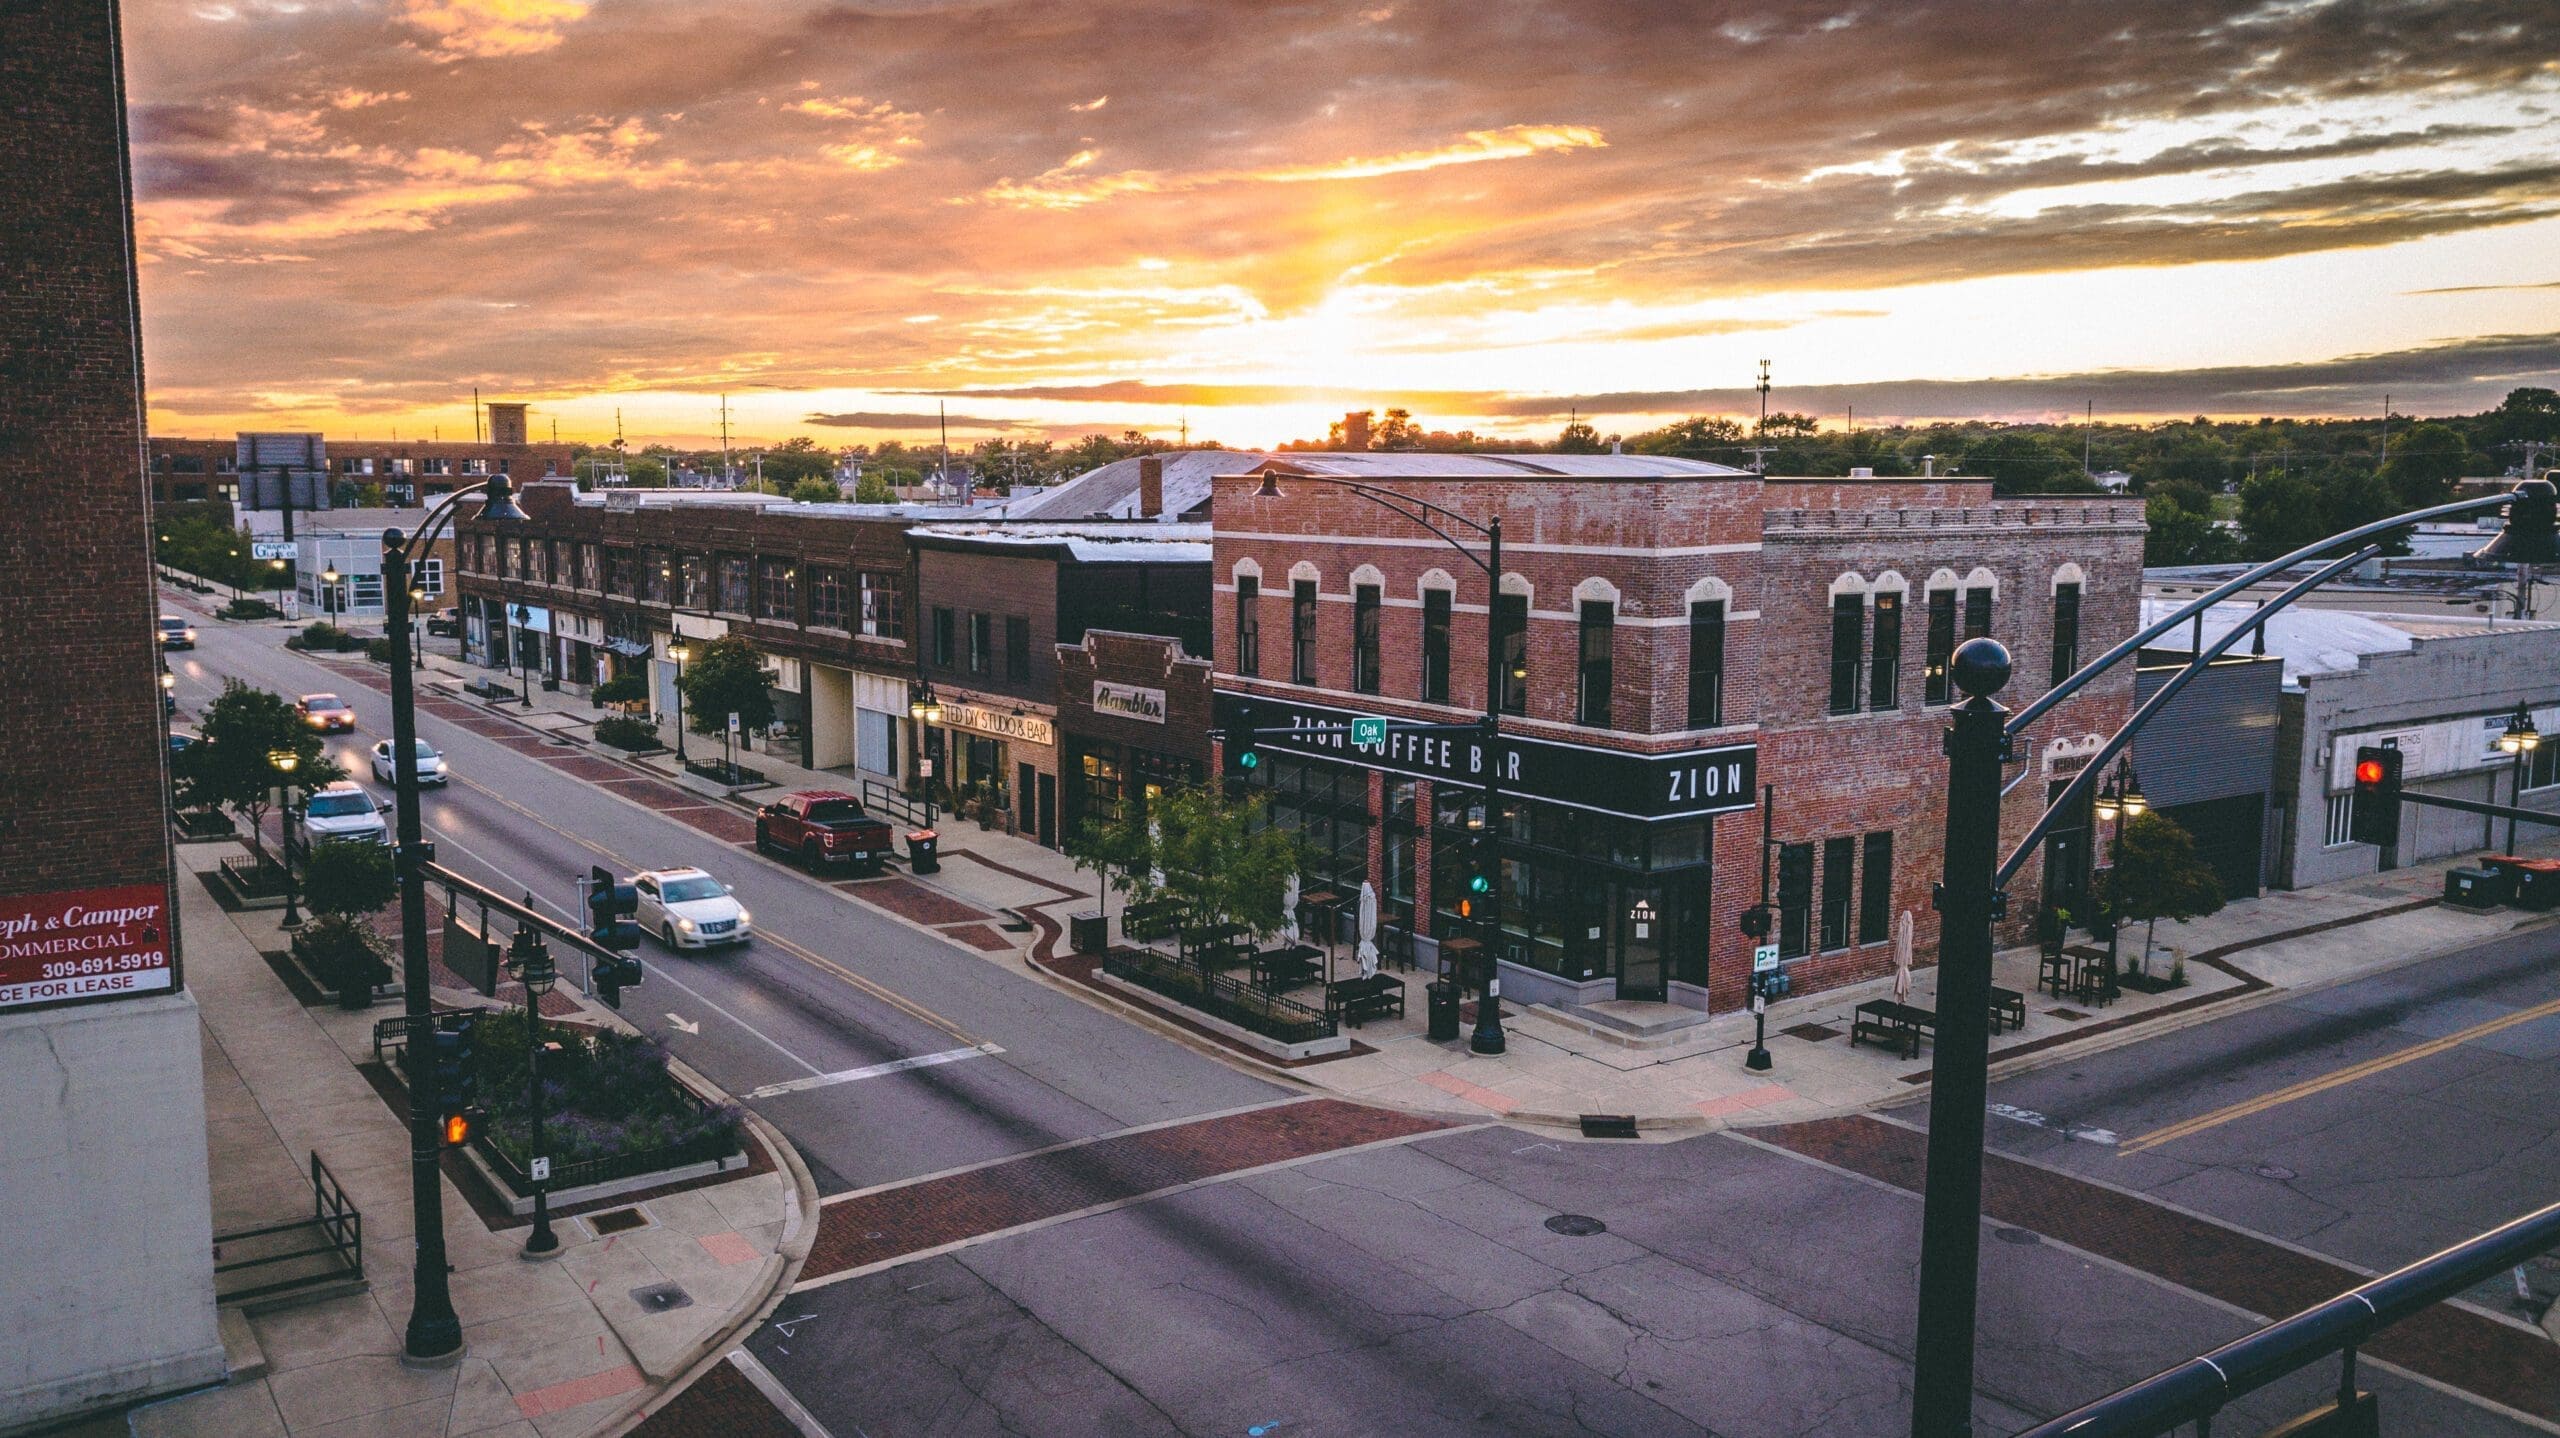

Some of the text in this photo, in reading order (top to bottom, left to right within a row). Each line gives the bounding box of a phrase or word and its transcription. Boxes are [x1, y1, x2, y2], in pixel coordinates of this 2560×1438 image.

[1097, 687, 1161, 717] Rambler
[939, 703, 1047, 742] FTED DIY STUDIO & BAR
[1360, 723, 1378, 736] Oak
[1292, 715, 1343, 749] ZION
[1470, 745, 1520, 780] BR
[2400, 733, 2421, 746] ETHOS
[2058, 756, 2089, 769] HOTE
[1669, 764, 1741, 801] ZION
[44, 915, 60, 931] &
[63, 905, 159, 927] Camper
[1630, 909, 1656, 921] ZION
[42, 951, 164, 978] 309-691-5919
[30, 983, 68, 999] FOR
[74, 975, 134, 993] LEASE
